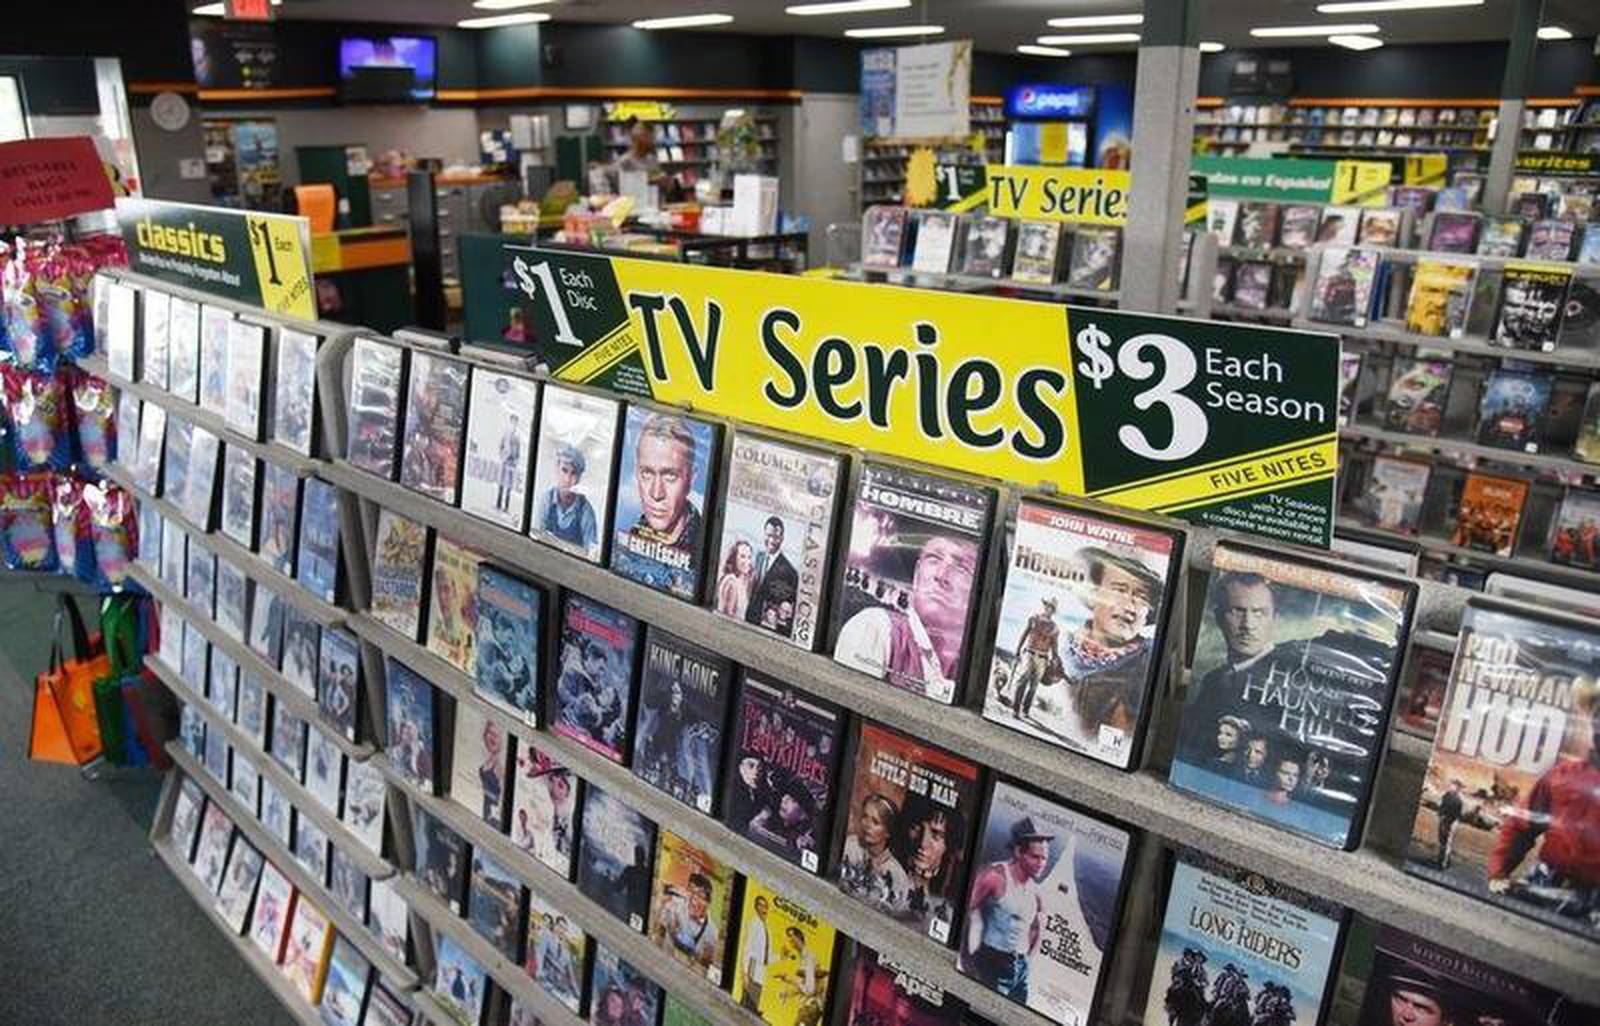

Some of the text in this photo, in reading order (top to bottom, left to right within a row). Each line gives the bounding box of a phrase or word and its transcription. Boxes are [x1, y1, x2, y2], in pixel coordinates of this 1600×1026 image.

[990, 176, 1029, 210] TV
[136, 216, 226, 264] classics
[250, 219, 283, 286] $1
[513, 256, 584, 347] $1
[559, 267, 595, 290] Each
[565, 290, 599, 312] Disc
[629, 292, 1067, 460] TV Series
[1205, 347, 1283, 383] Each
[1076, 323, 1209, 461] $3
[1206, 381, 1325, 423] Season
[1210, 450, 1327, 489] FIVE NITES
[861, 485, 985, 529] HOMBRE
[1050, 515, 1138, 546] JOHN WAYNE
[796, 505, 825, 641] CLASSICS
[651, 642, 720, 698] KING KONG
[1441, 683, 1567, 775] HUD
[869, 757, 960, 809] LITTLE BIG MAN
[1189, 906, 1304, 970] LONG RIDERS
